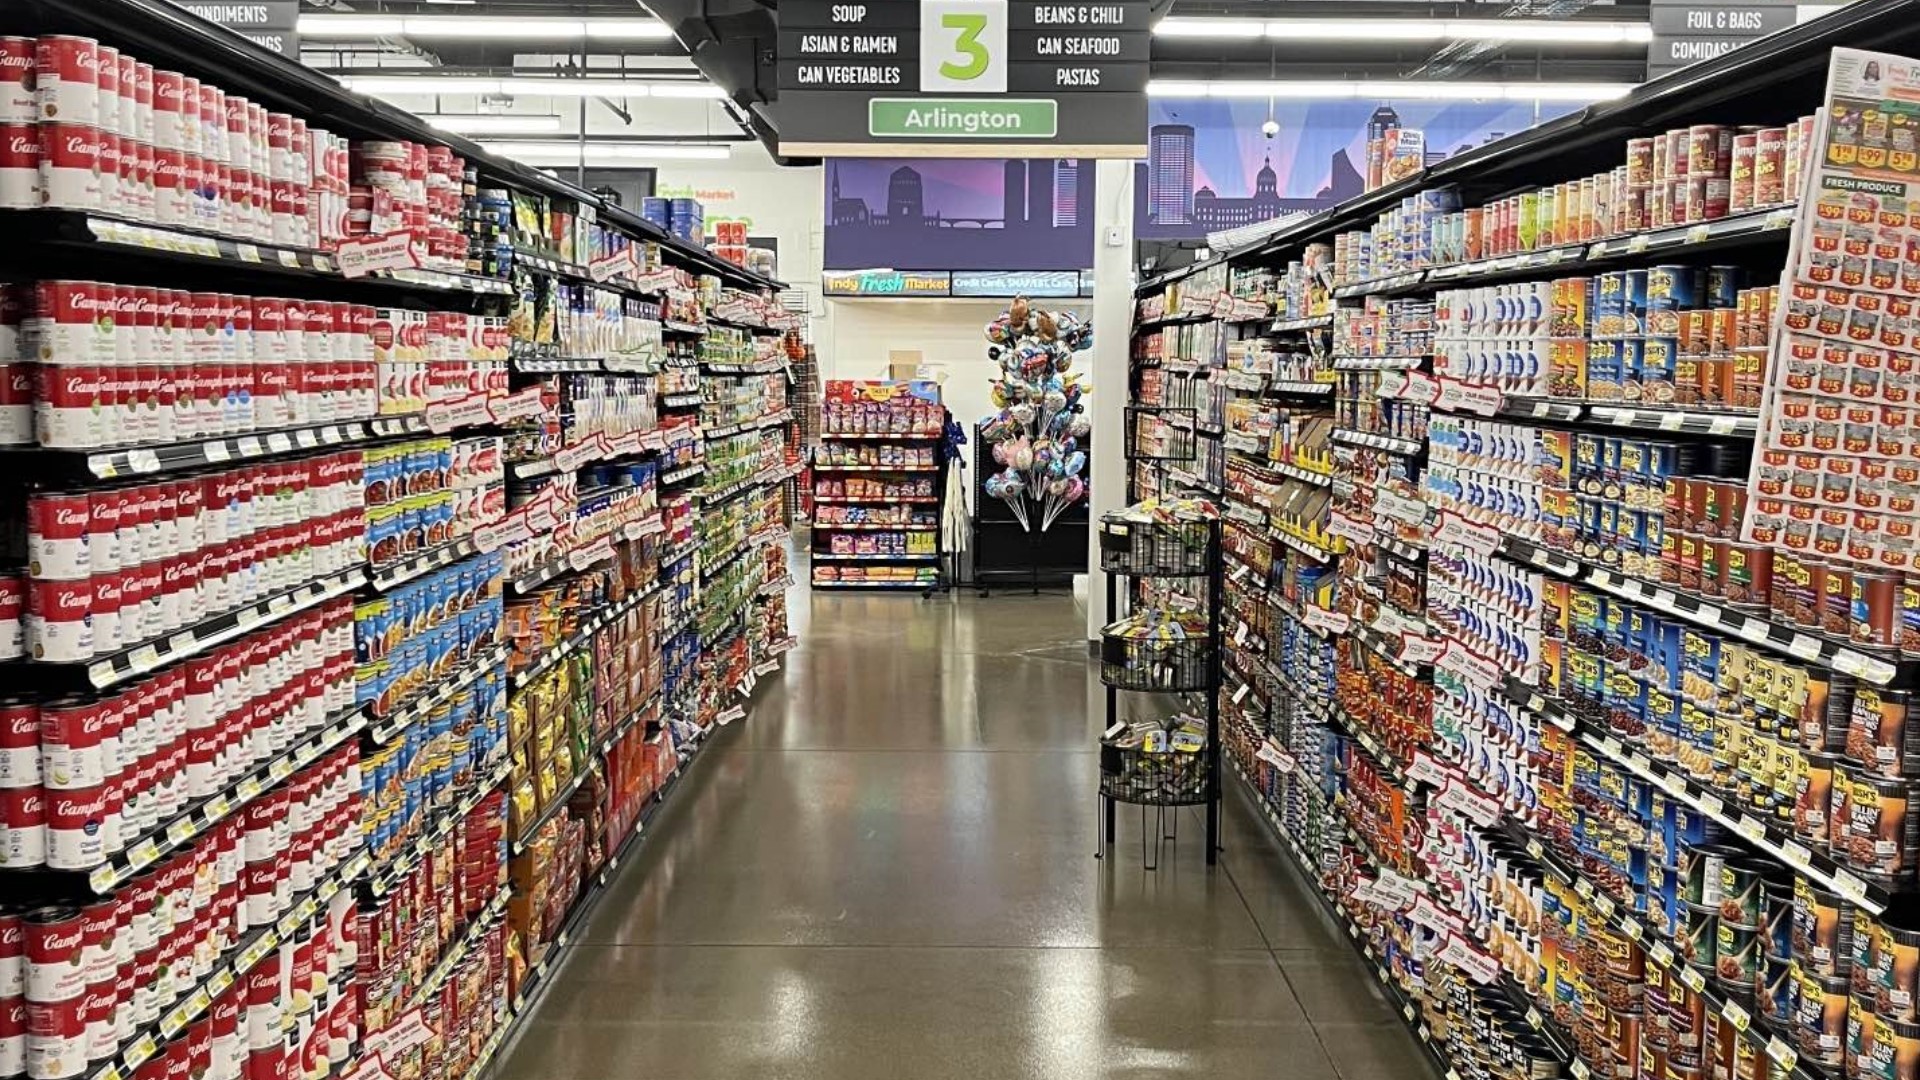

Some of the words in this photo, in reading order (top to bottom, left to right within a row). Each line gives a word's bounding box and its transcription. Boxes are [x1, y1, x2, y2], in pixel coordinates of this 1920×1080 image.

[832, 5, 867, 22] SOUP
[1035, 7, 1075, 24] BEANS
[1078, 8, 1088, 24] &
[1090, 7, 1124, 24] CHILI
[1687, 11, 1713, 28] FOIL
[1717, 11, 1725, 28] &
[1729, 12, 1762, 28] BAGS
[801, 35, 838, 53] ASIAN
[841, 36, 850, 53] &
[853, 36, 897, 53] RAMEN
[939, 14, 989, 80] 3
[1037, 38, 1061, 55] CAN
[1065, 38, 1120, 55] SEAFOOD
[1671, 42, 1728, 59] COMIDAS
[798, 66, 823, 83] CAN
[826, 66, 900, 84] VEGETABLES
[1056, 68, 1100, 85] PASTAS
[904, 107, 1021, 132] Arlington
[1826, 178, 1855, 189] FRESH
[1857, 180, 1902, 194] PRODUCE
[905, 278, 949, 291] Market
